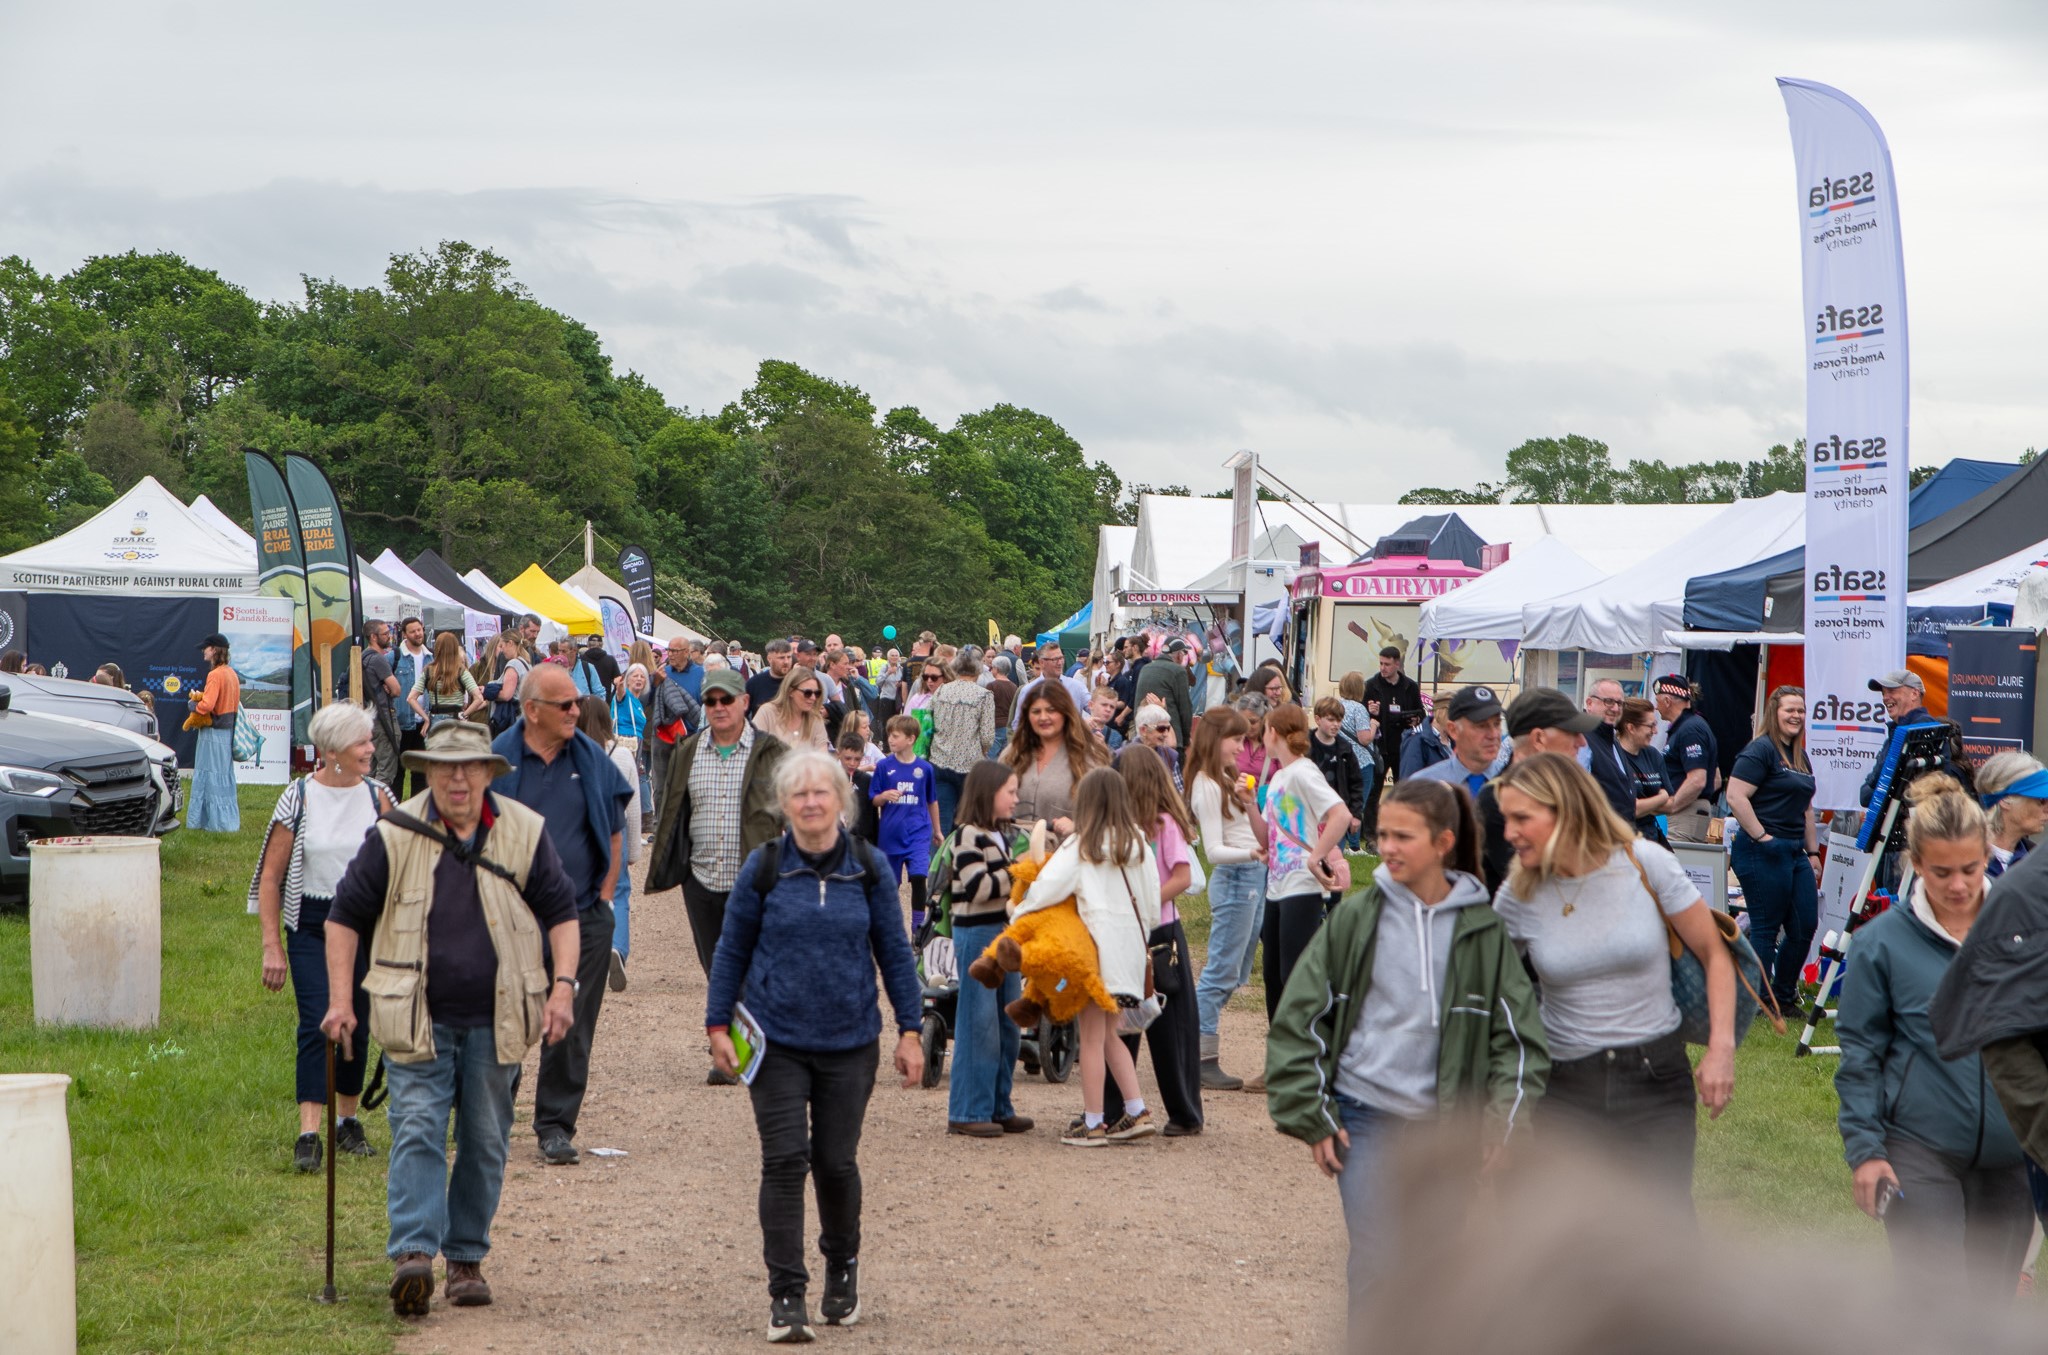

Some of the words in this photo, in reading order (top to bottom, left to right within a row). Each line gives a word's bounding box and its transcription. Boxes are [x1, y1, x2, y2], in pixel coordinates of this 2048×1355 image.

[304, 539, 335, 552] RIME
[13, 573, 59, 585] SCOTTISH
[63, 576, 129, 586] PARTNERSHIP
[133, 577, 175, 587] AGAINST
[178, 578, 209, 588] RURAL
[213, 578, 243, 588] CRIME
[1351, 577, 1474, 595] DAIRYMA
[1128, 593, 1157, 602] COLD
[1161, 594, 1200, 602] DRINKS
[236, 607, 267, 615] Scottish
[1952, 674, 1996, 686] DRUMMOND
[1997, 675, 2024, 687] LAURIE
[1951, 690, 1983, 698] CHARTERED
[1984, 692, 2023, 700] ACCOUNTANTS
[262, 713, 282, 721] rural
[263, 723, 286, 732] thrive
